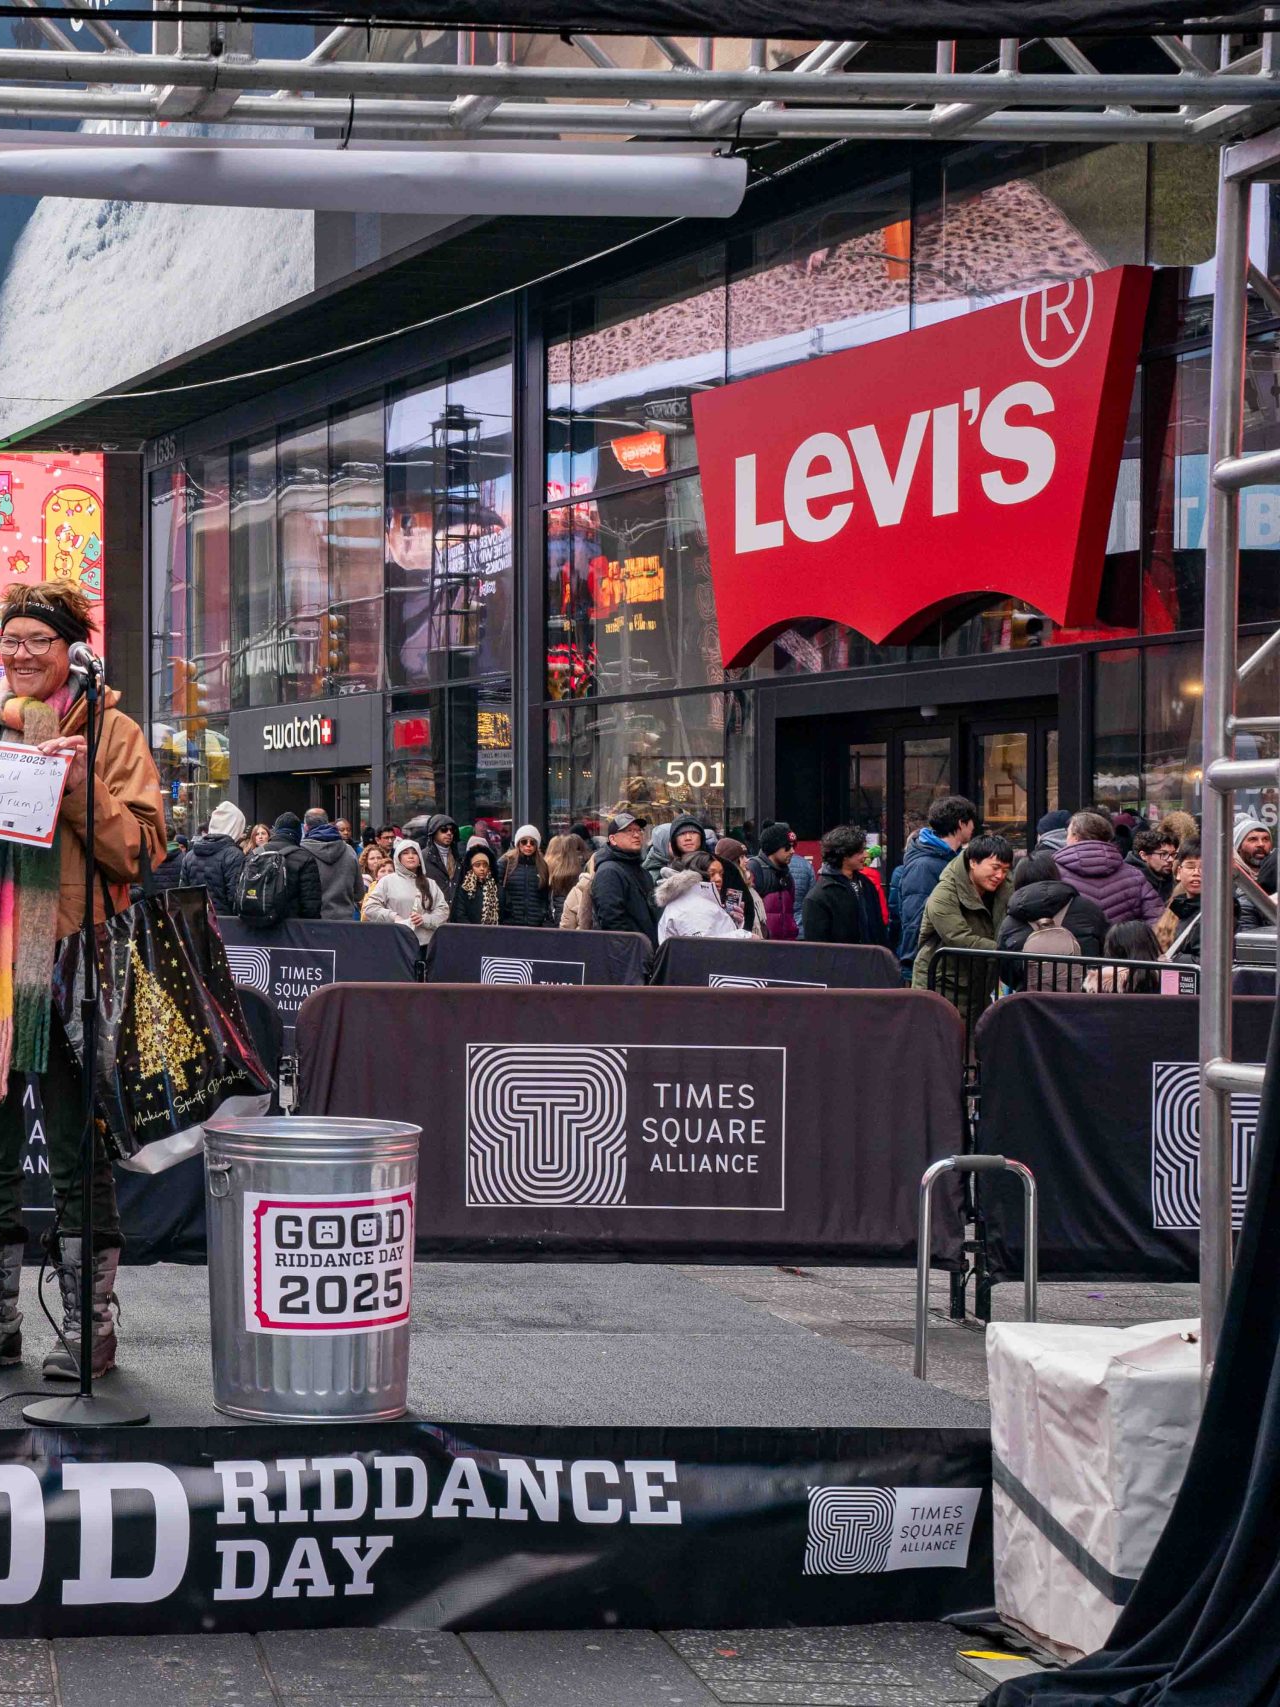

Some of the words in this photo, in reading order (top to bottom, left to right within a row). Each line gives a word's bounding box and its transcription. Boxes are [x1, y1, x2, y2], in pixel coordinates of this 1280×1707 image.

[263, 714, 321, 750] swatch
[20, 755, 47, 765] 2025
[666, 761, 725, 787] 501
[279, 966, 323, 980] TIMES
[134, 1109, 171, 1131] Making
[172, 1089, 206, 1113] Spirits
[207, 1069, 249, 1095] Bright
[653, 1083, 755, 1109] TIMES
[642, 1118, 766, 1148] SQUARE
[650, 1154, 759, 1173] ALLIANCE
[275, 1208, 405, 1250] GOOD
[275, 1251, 374, 1268] RIDDANCE
[378, 1246, 405, 1263] DAY
[279, 1267, 403, 1315] 2025
[213, 1456, 682, 1525] RIDDANCE
[910, 1505, 964, 1521] TIMES
[899, 1522, 966, 1540] SQUARE
[900, 1540, 958, 1553] ALLIANCE
[213, 1536, 394, 1601] DAY
